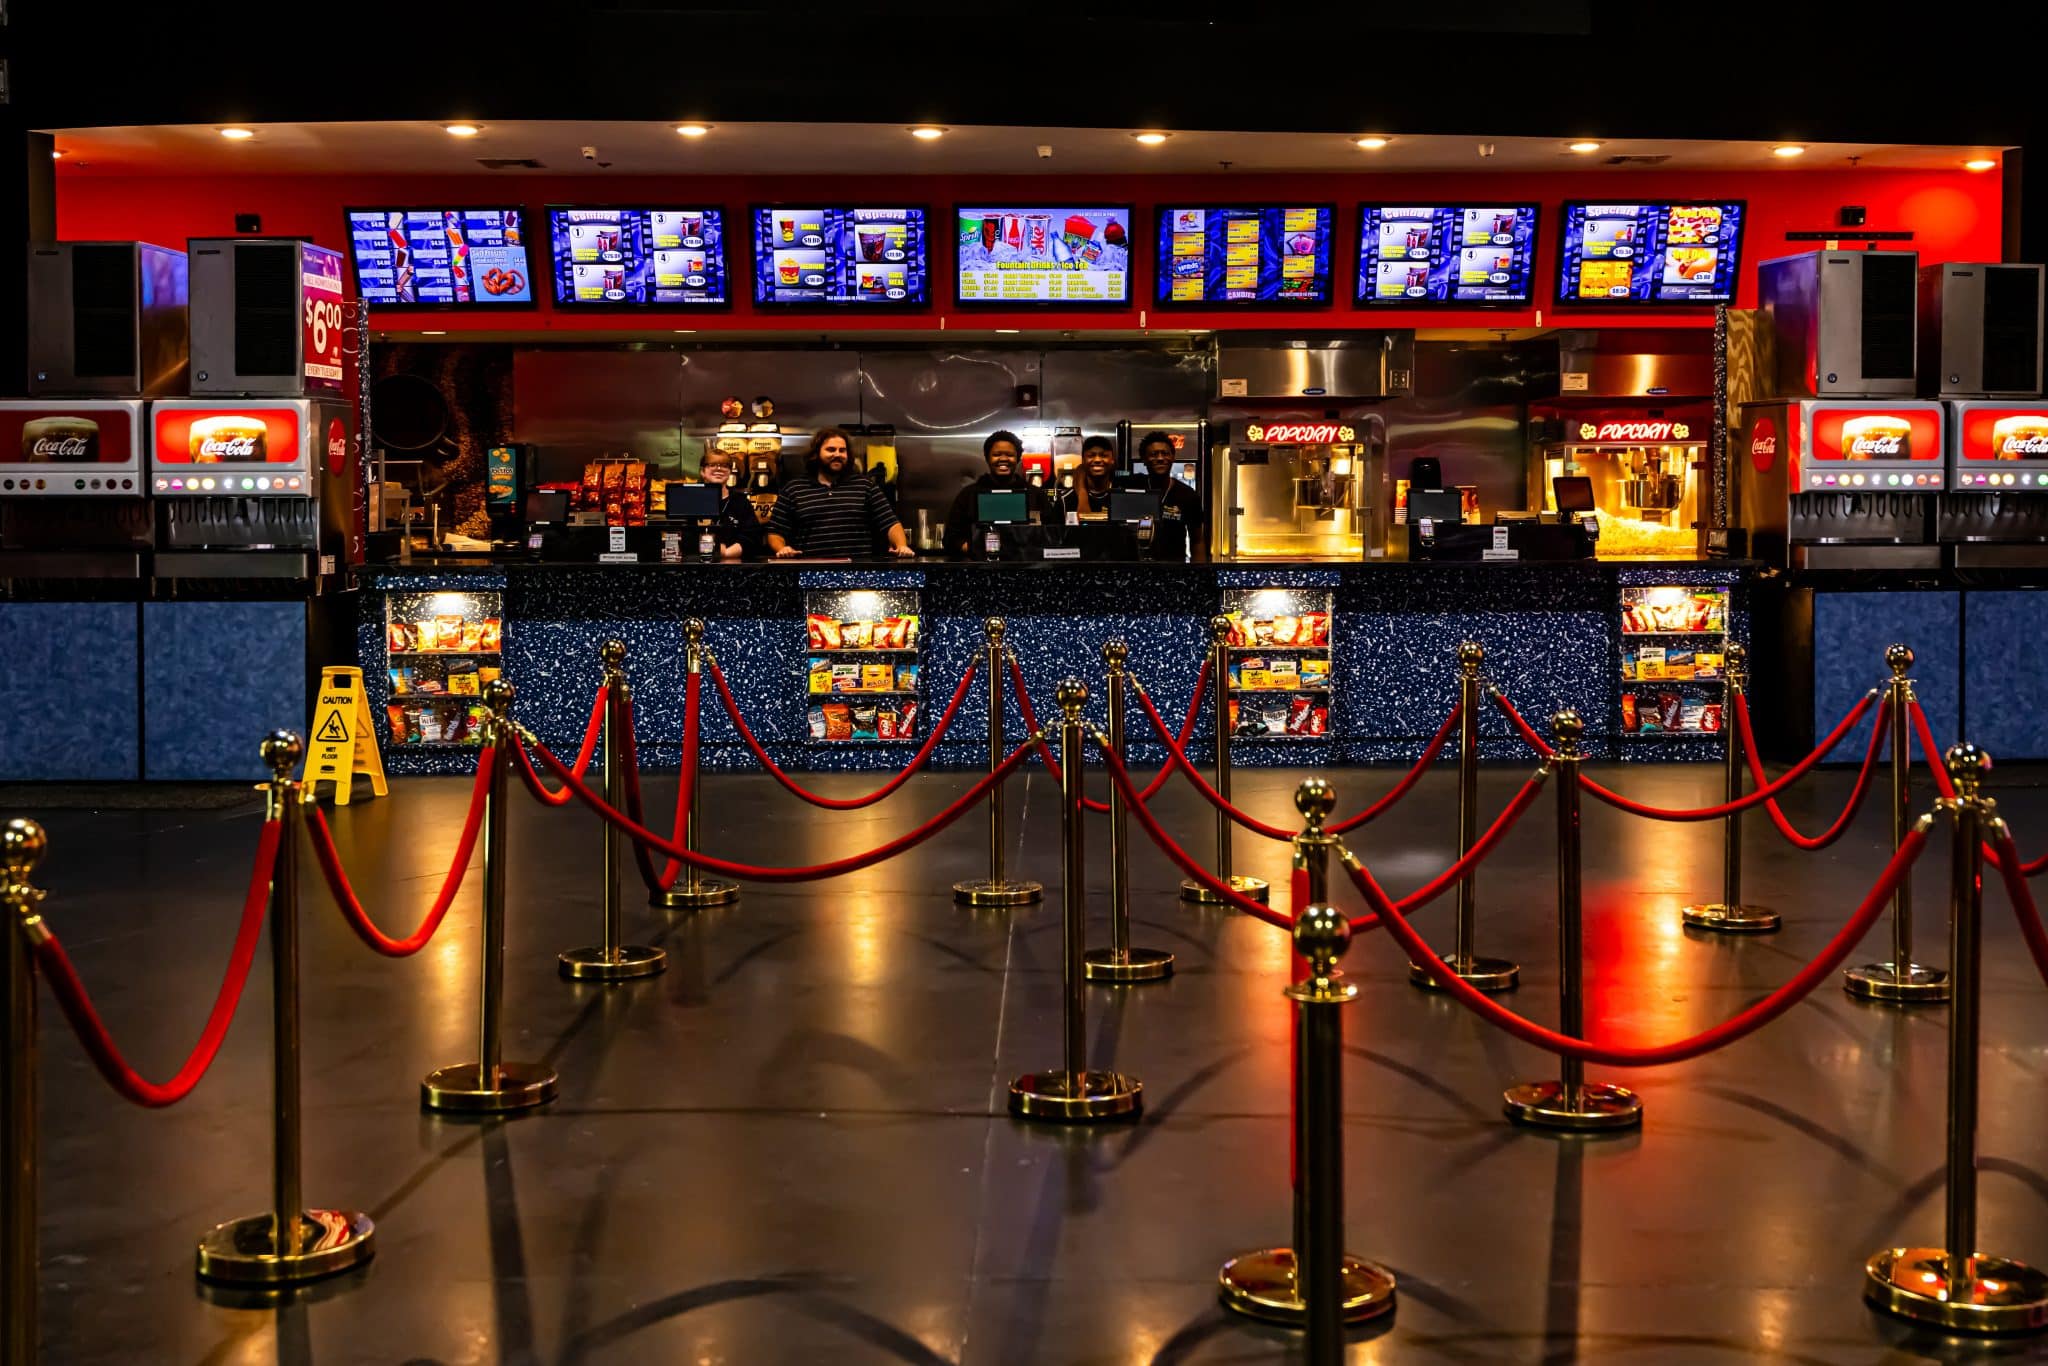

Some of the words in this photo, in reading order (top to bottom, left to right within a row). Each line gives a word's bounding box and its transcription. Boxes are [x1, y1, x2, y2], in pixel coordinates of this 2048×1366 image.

[857, 209, 906, 220] Popcorn
[1265, 425, 1338, 442] POPCORN
[1599, 423, 1672, 439] POPCORN
[33, 437, 88, 455] Coca-Cola
[200, 438, 256, 456] Coca-Cola
[1851, 436, 1901, 454] Coca-Cola
[322, 696, 352, 704] CAUTION
